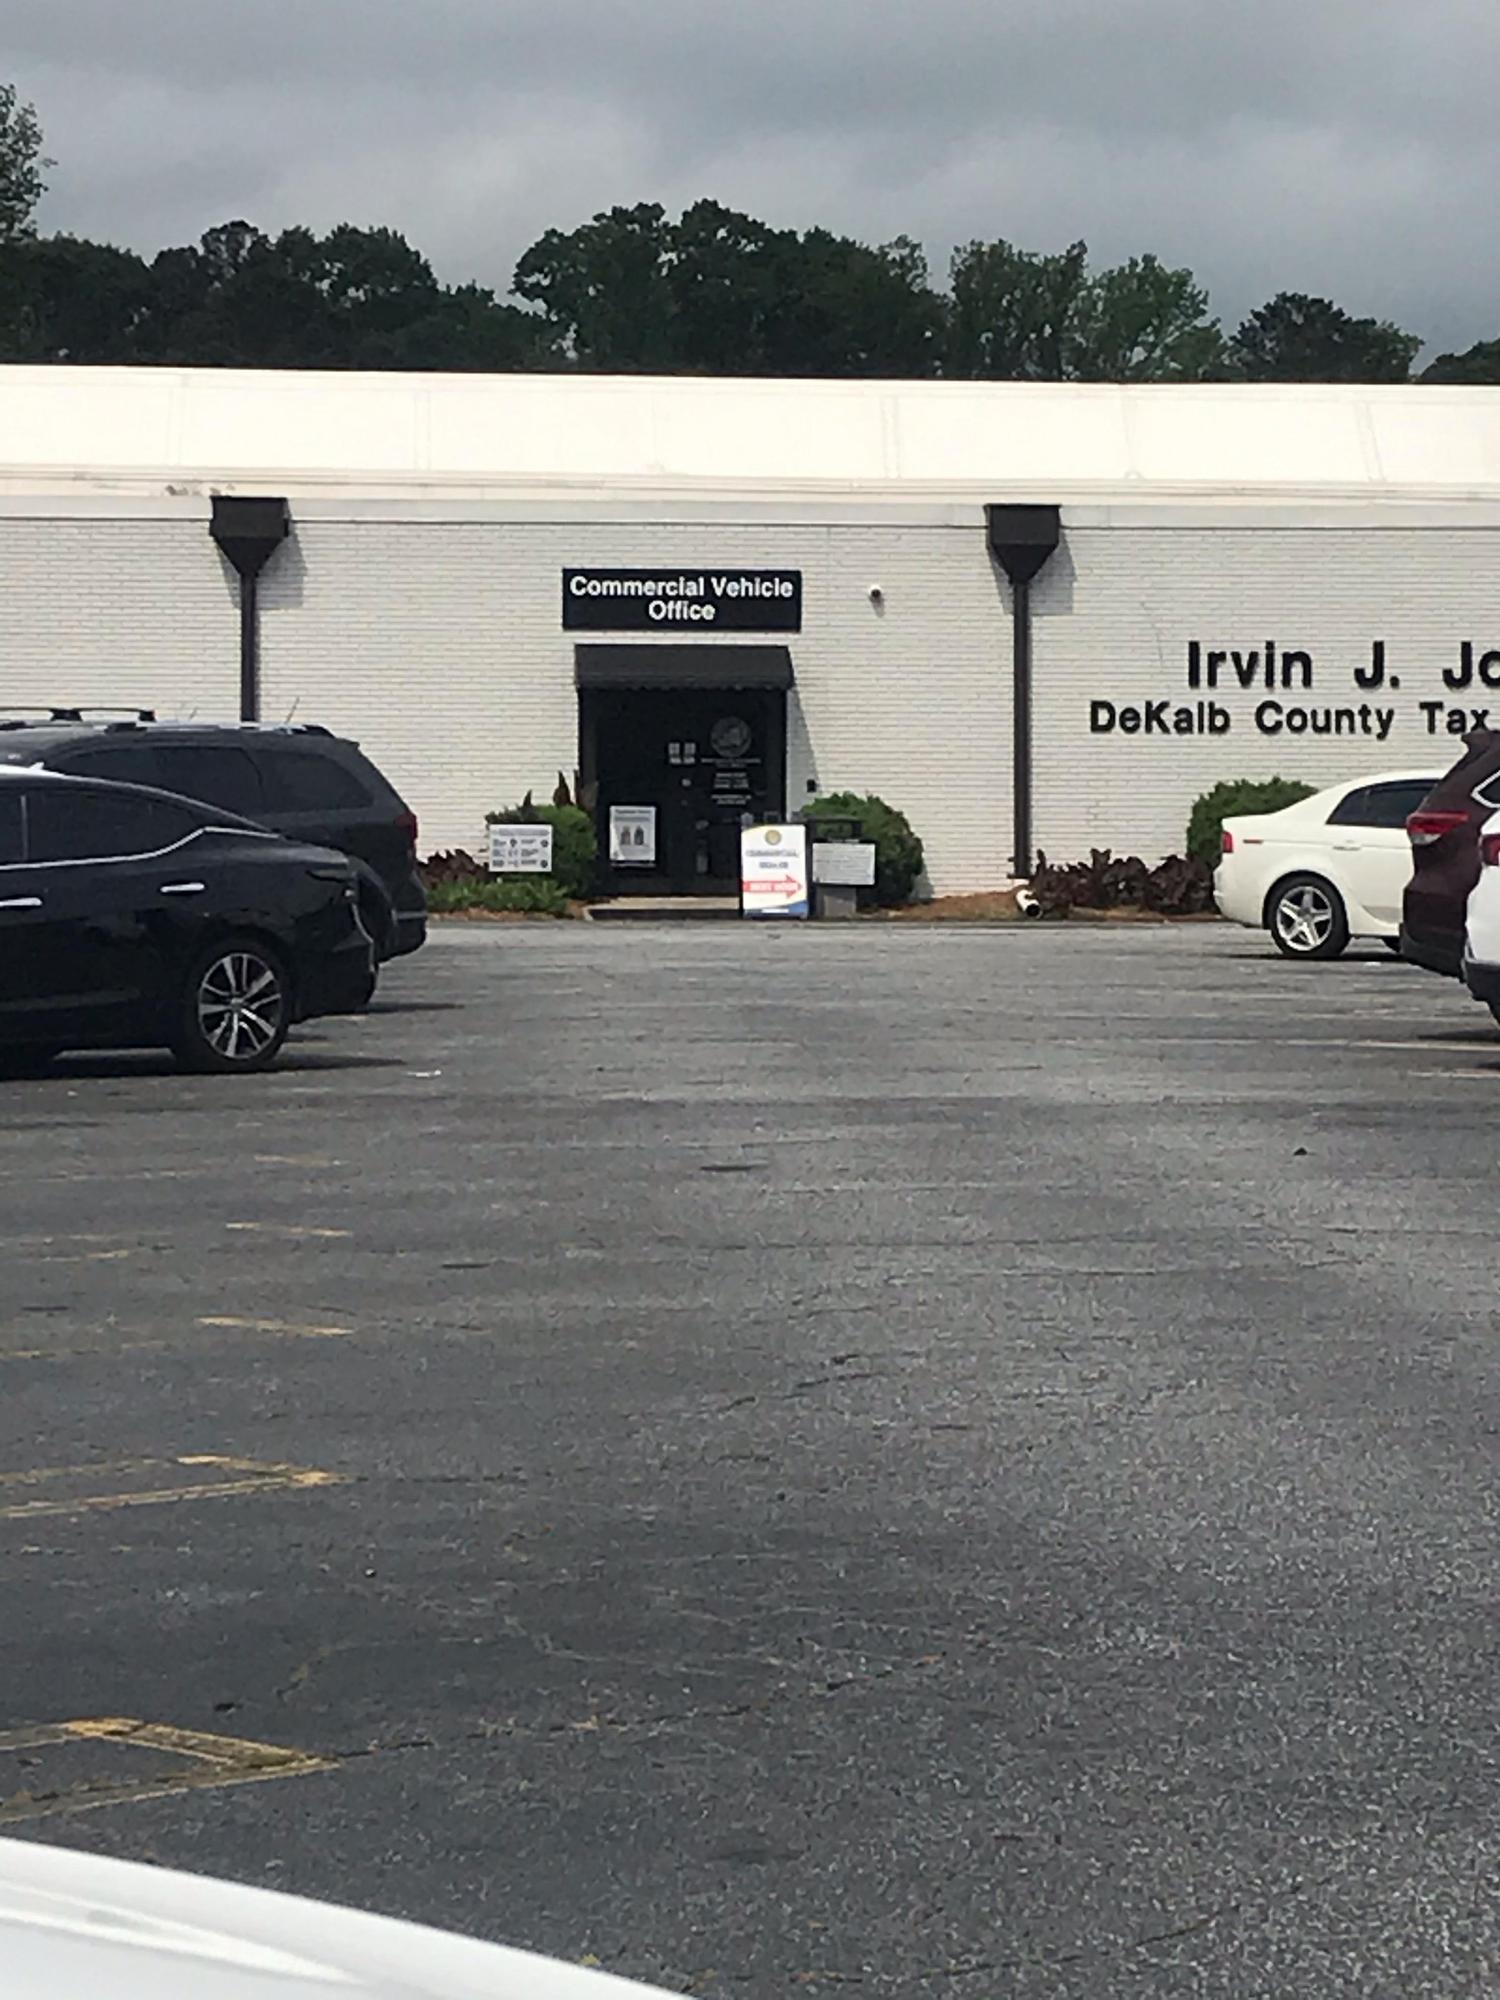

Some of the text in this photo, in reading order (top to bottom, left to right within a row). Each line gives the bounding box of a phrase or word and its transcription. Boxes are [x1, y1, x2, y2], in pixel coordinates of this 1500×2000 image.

[569, 575, 794, 598] Commercial Vehicle
[648, 600, 716, 621] Office
[1188, 640, 1312, 689] Irvin
[1353, 640, 1400, 690] J.
[1090, 700, 1490, 741] DeKalb County Tax
